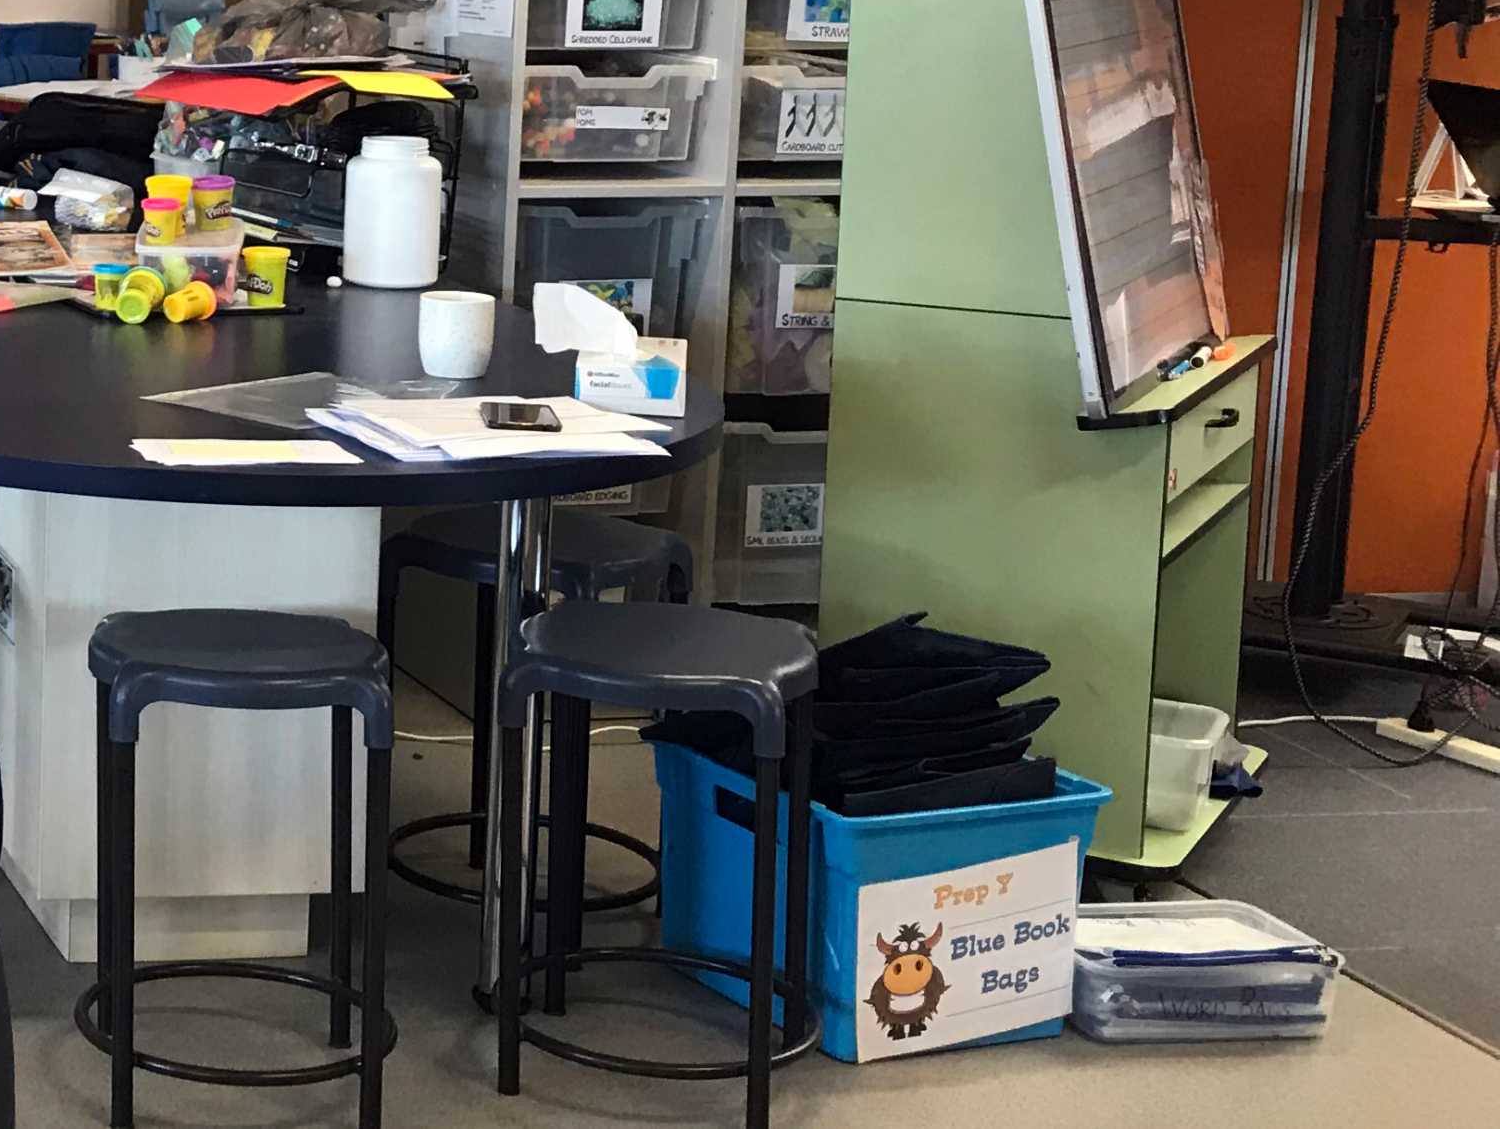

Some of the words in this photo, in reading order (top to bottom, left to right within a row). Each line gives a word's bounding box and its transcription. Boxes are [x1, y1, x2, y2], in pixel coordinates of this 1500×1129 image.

[781, 313, 818, 326] STRING
[932, 883, 990, 910] Prep
[995, 871, 1014, 895] Y
[950, 933, 1006, 960] Blue
[1013, 912, 1071, 945] Book
[981, 965, 1040, 994] Bags
